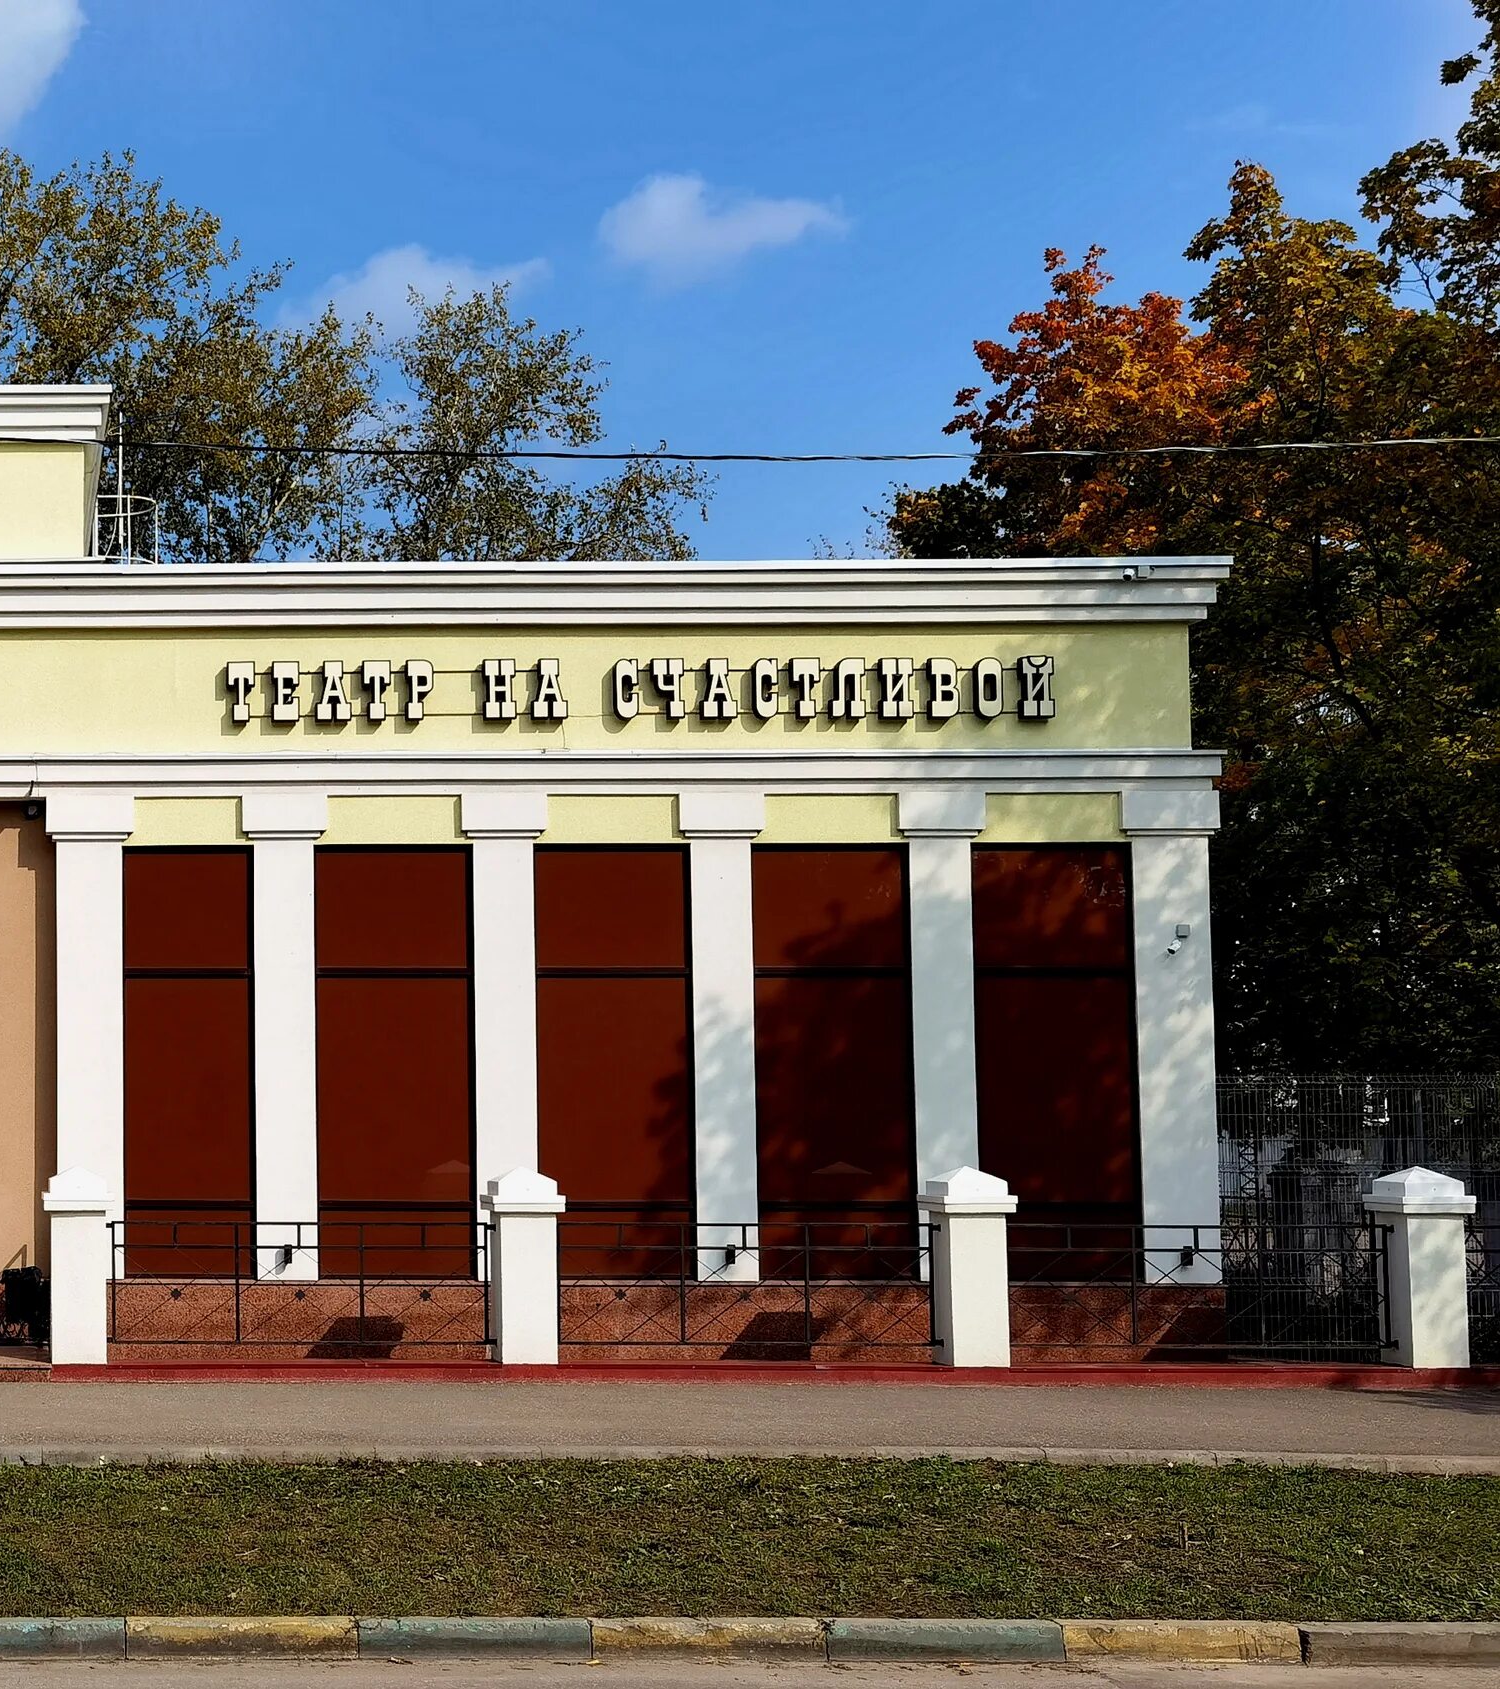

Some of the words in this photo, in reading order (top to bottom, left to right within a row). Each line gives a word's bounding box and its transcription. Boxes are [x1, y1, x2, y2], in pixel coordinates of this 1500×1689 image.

[225, 660, 434, 723] ТЕАТР
[481, 658, 569, 722] НА
[612, 655, 1056, 721] СЧАСТЛИВОЙ
